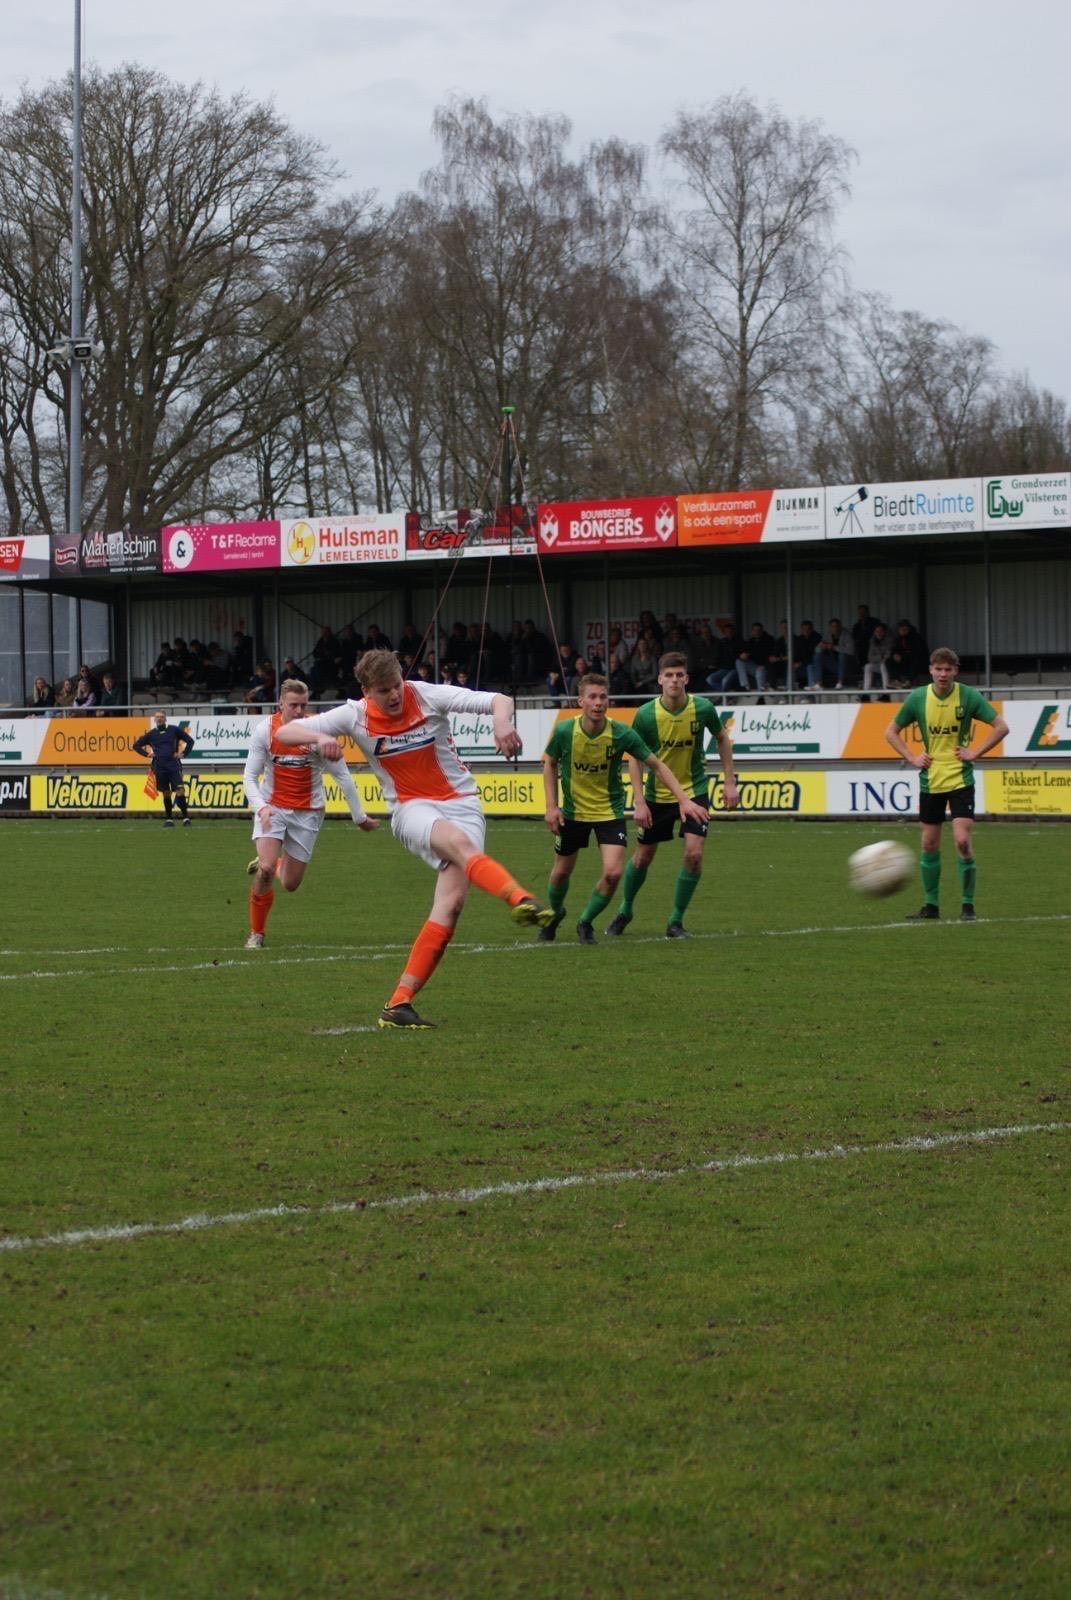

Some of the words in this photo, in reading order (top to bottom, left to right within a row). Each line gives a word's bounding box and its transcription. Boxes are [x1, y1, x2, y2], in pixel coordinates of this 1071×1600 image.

[1011, 477, 1067, 489] Grondverzet
[683, 500, 757, 513] Verduurzamen
[776, 497, 819, 511] DIJKMAN
[1024, 493, 1067, 503] Vilsteren
[570, 517, 644, 539] BONGERS
[684, 517, 692, 528] is
[695, 517, 711, 527] ook
[713, 517, 732, 526] een
[735, 513, 762, 526] sport!
[82, 536, 157, 558] Manenschijn
[319, 527, 399, 548] Hulsman
[423, 529, 469, 550] Car
[319, 548, 399, 562] LEMELERVELD
[195, 720, 252, 747] Lenferink
[741, 711, 811, 740] Lenferink
[53, 729, 149, 752] Onderhou
[1002, 771, 1041, 786] Fokkert
[47, 777, 125, 807] Vekoma
[849, 781, 912, 812] ING
